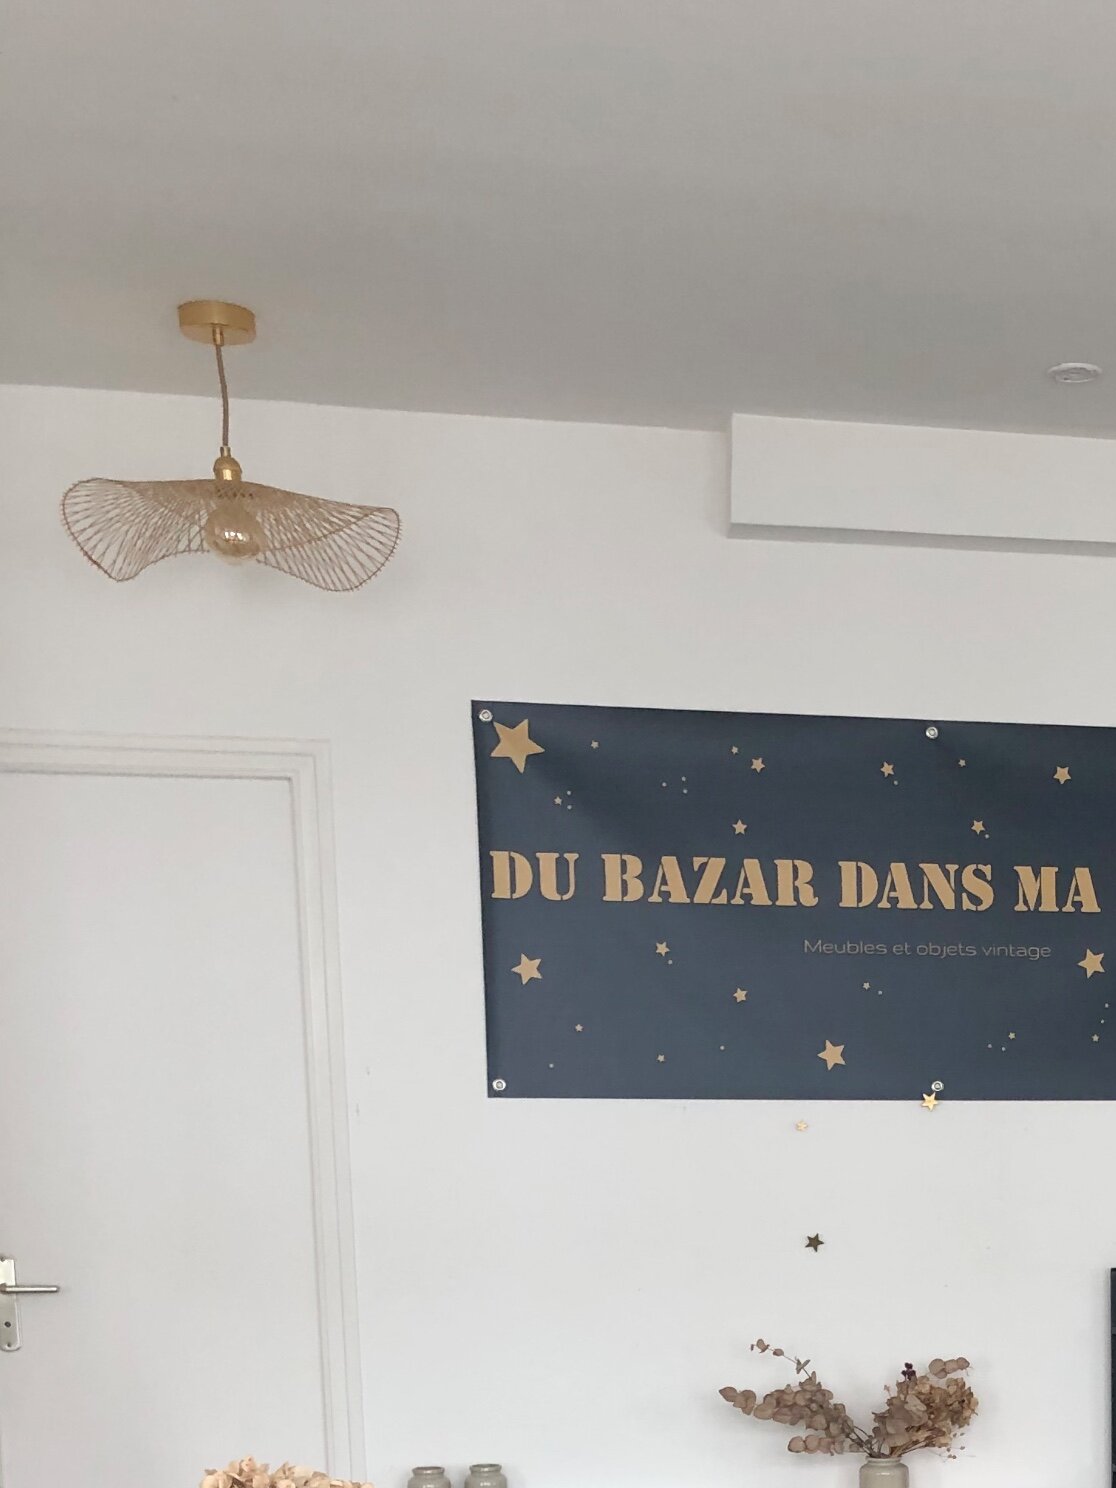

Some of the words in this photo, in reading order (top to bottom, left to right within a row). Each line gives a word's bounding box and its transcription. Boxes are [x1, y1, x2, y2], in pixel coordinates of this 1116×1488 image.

[490, 850, 578, 901] DU
[602, 853, 819, 908] BAZAR
[839, 860, 995, 912] DANS
[1014, 865, 1101, 914] MA
[803, 939, 888, 955] Meubles
[892, 942, 911, 956] et
[916, 941, 977, 959] objets
[982, 942, 1052, 961] vintage
